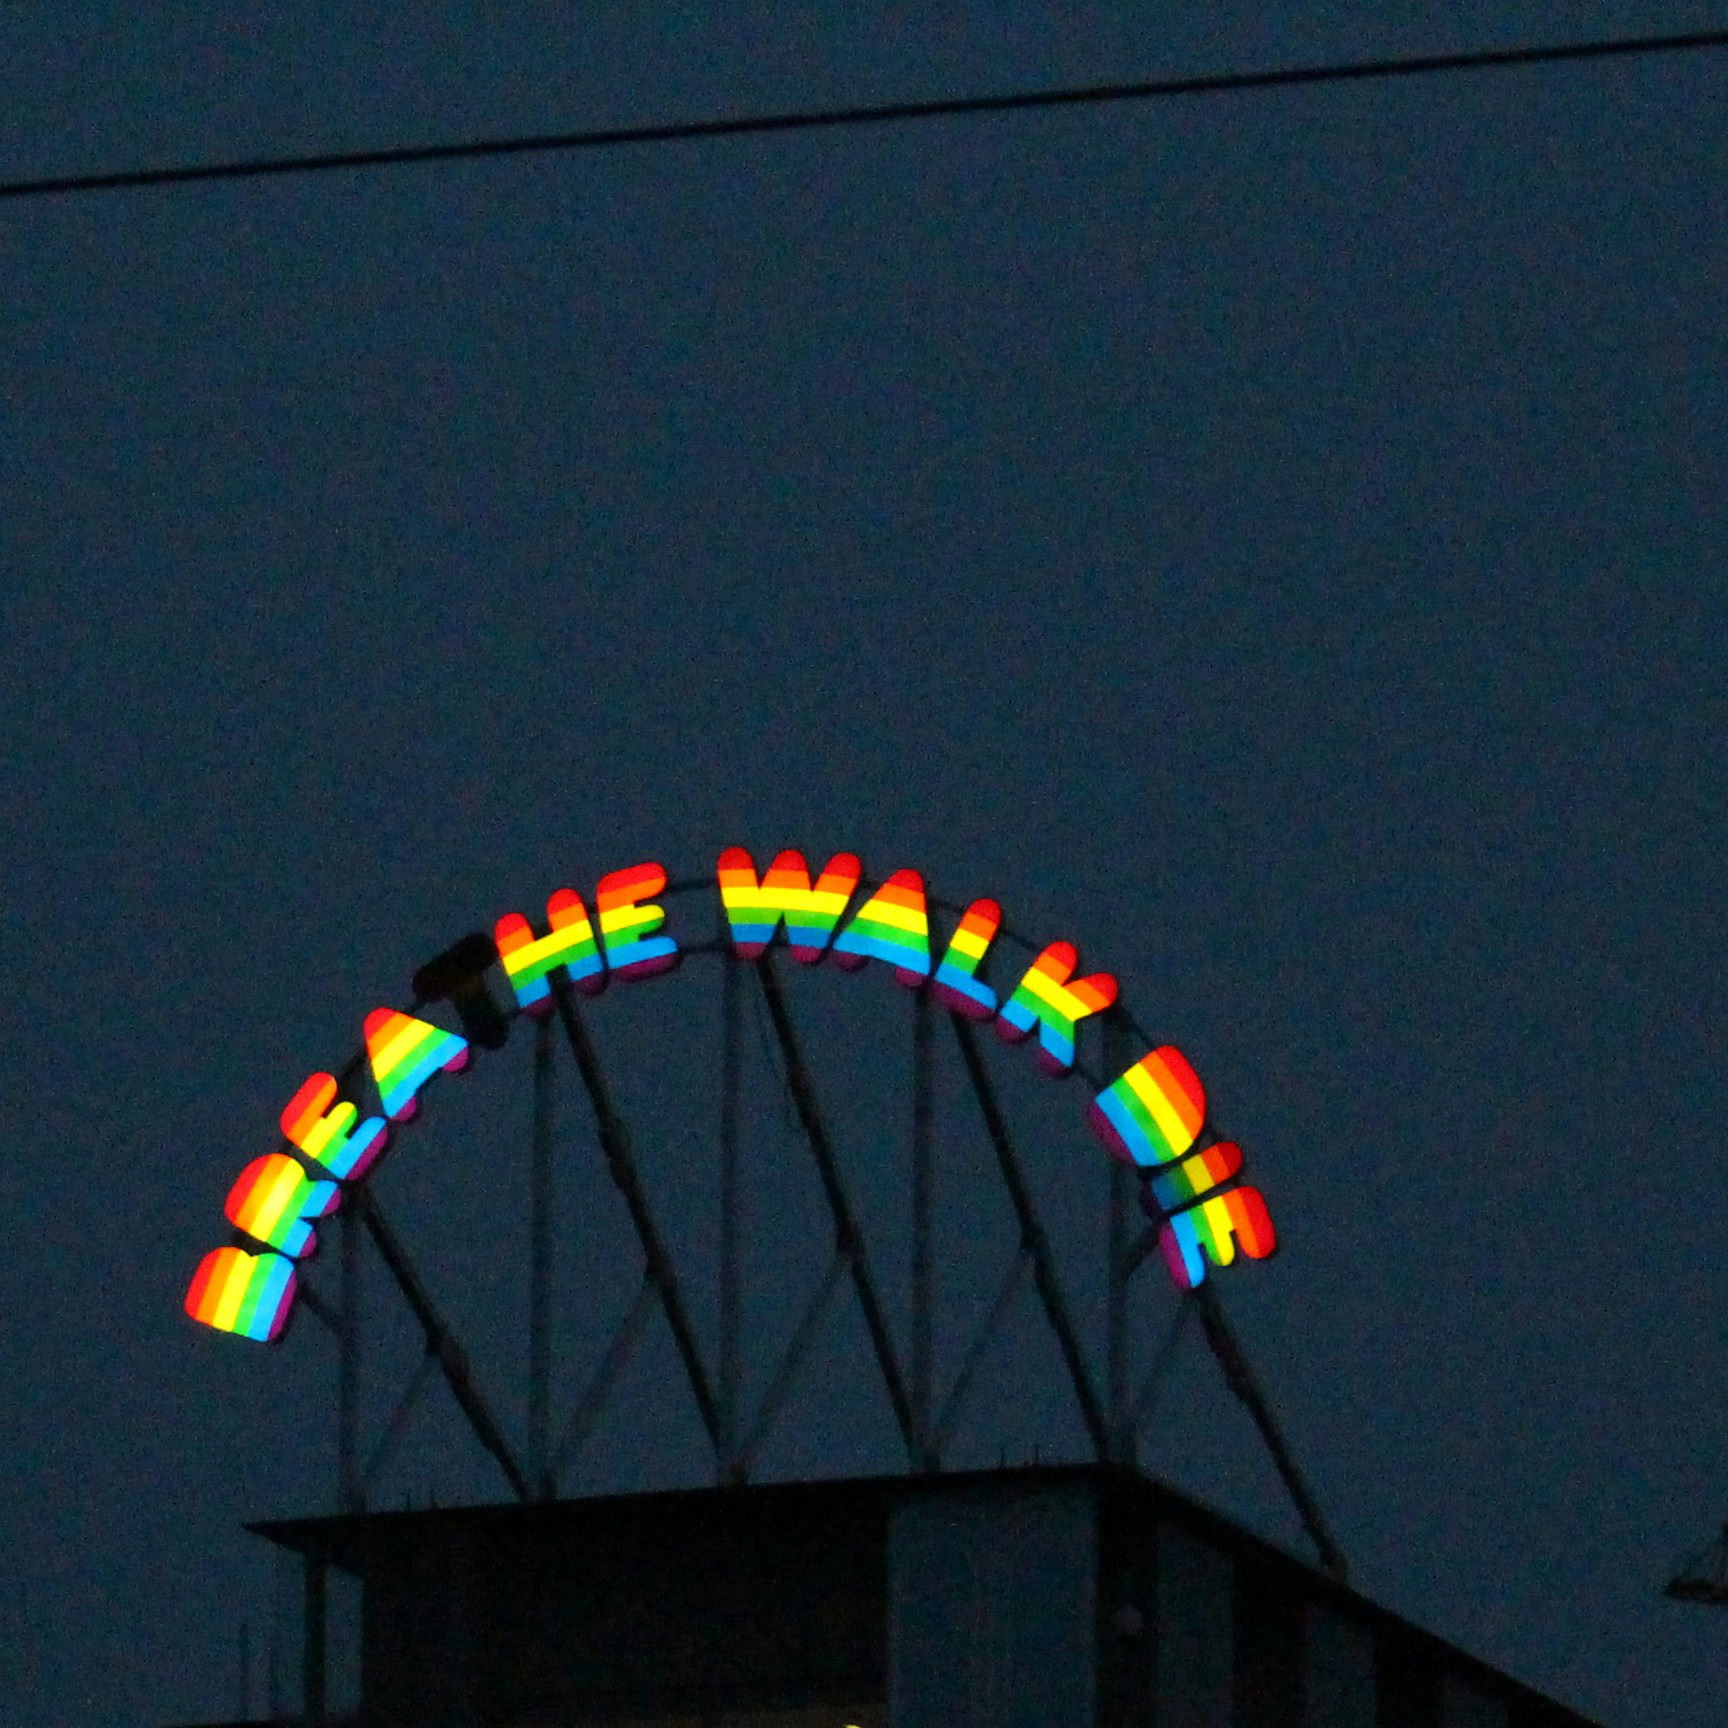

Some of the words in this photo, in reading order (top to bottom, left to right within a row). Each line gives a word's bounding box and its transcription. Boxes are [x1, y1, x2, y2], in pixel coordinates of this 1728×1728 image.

[181, 860, 680, 1343] BREATHE
[714, 845, 1120, 1080] WALK
[1084, 1044, 1277, 1292] DIE
